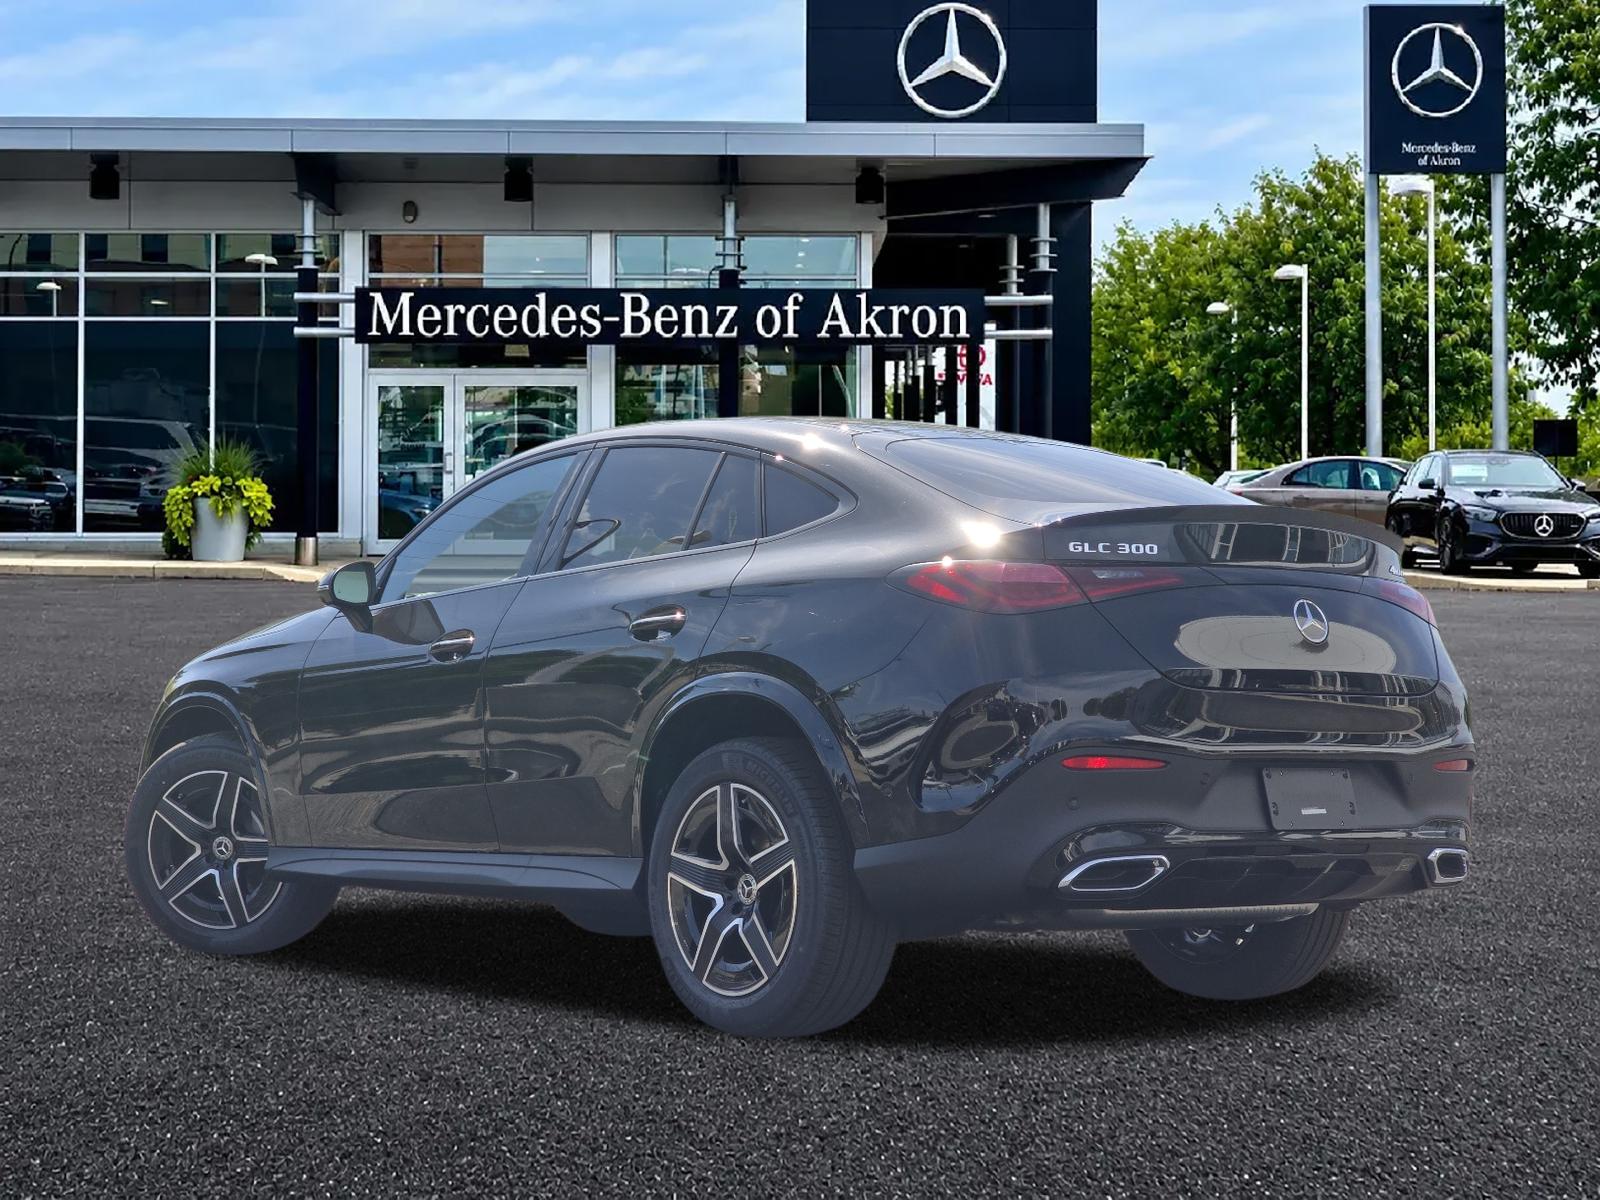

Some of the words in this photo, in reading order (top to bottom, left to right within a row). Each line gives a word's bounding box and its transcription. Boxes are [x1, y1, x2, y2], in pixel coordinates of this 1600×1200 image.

[1401, 142, 1476, 154] Mercedes-Benz
[1417, 154, 1428, 166] of
[1430, 154, 1461, 166] Akron
[367, 291, 738, 339] Mercedes-Benz
[755, 292, 804, 339] of
[816, 291, 971, 339] Akron
[1068, 541, 1111, 554] GLC
[1117, 543, 1158, 555] 300
